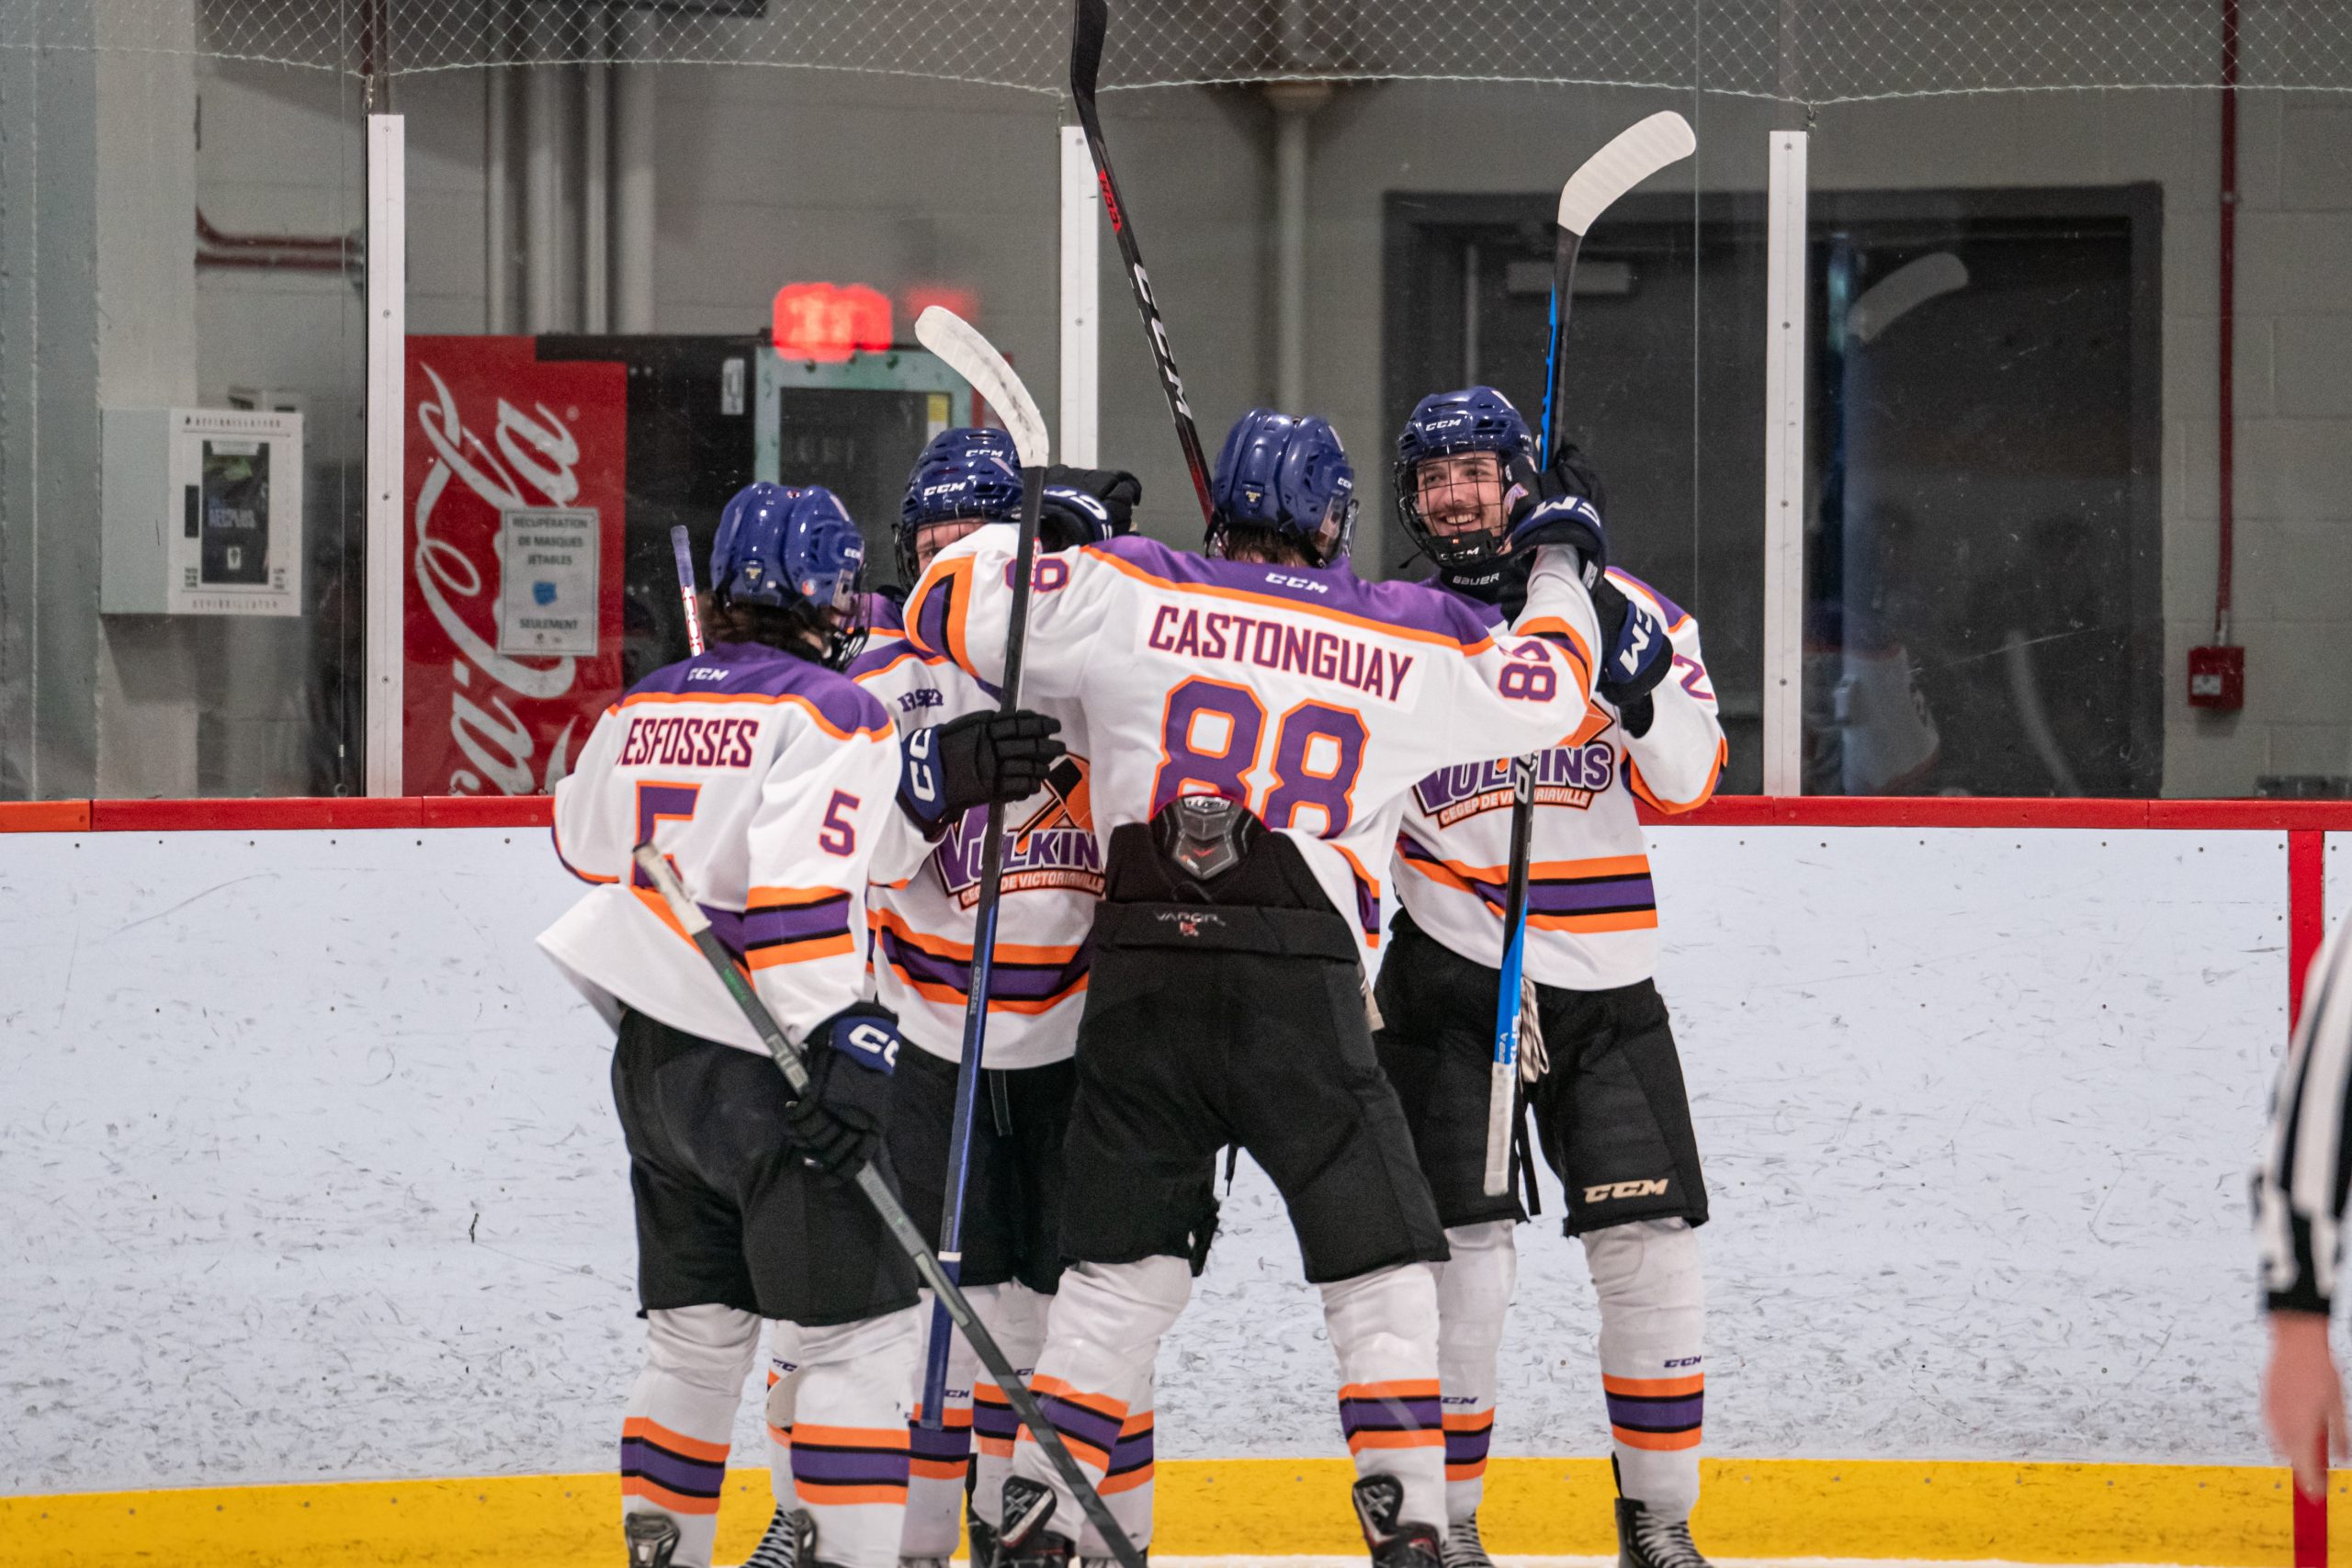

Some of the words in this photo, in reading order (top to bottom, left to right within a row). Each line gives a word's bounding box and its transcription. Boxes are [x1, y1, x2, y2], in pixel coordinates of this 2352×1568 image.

[1134, 263, 1193, 420] CCM
[1425, 419, 1462, 432] CCM
[966, 448, 1003, 457] CCM
[923, 481, 966, 497] CCM
[534, 536, 583, 548] MASQUES
[527, 554, 572, 565] JETABLES
[1265, 572, 1329, 593] CCM
[519, 618, 578, 629] SEULEMENT
[1148, 604, 1414, 702] CASTONGUAY
[688, 667, 729, 681] CCM
[616, 717, 760, 768] ESFOSSES
[1148, 674, 1371, 840] 88
[1414, 741, 1616, 816] VULINS
[1440, 798, 1480, 825] CEGEP
[1481, 793, 1498, 807] DE
[1499, 787, 1590, 805] VIRIAVILLE
[819, 789, 861, 857] 5
[1583, 1179, 1668, 1204] CCM
